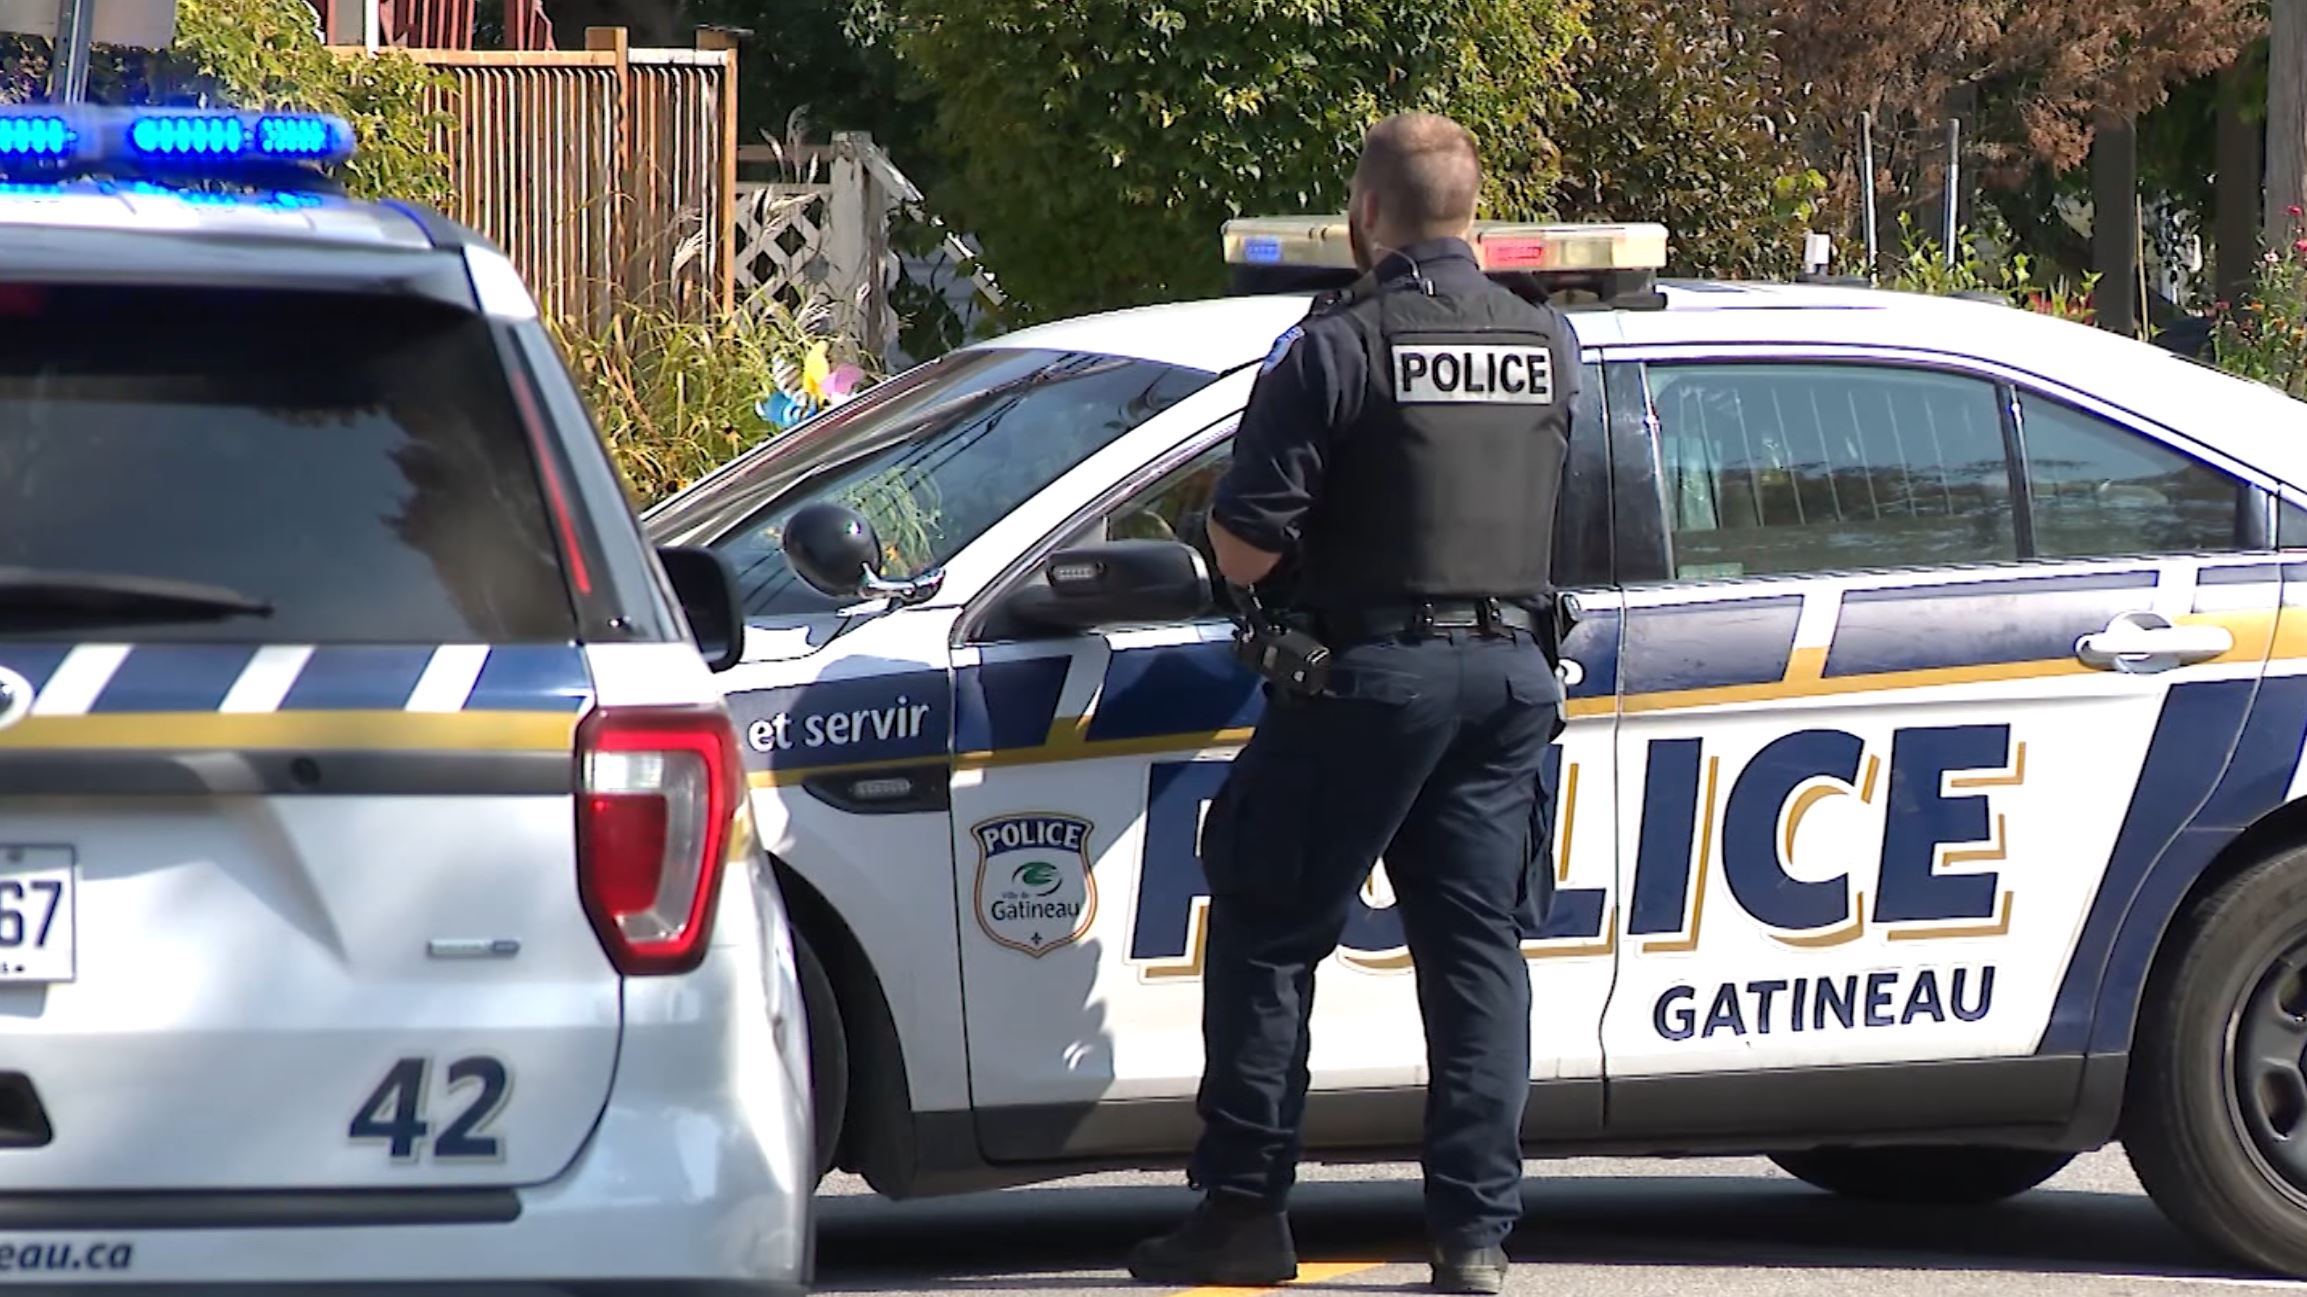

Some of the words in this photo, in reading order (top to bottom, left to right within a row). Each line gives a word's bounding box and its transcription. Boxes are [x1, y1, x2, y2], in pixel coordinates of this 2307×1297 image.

[1400, 351, 1548, 395] POLICE
[749, 711, 792, 752] et
[804, 695, 930, 747] servir
[982, 820, 1083, 852] POLICE
[0, 880, 62, 947] 67
[991, 900, 1079, 921] Gatineau
[1652, 964, 1996, 1043] GATINEAU
[348, 1055, 508, 1160] 42
